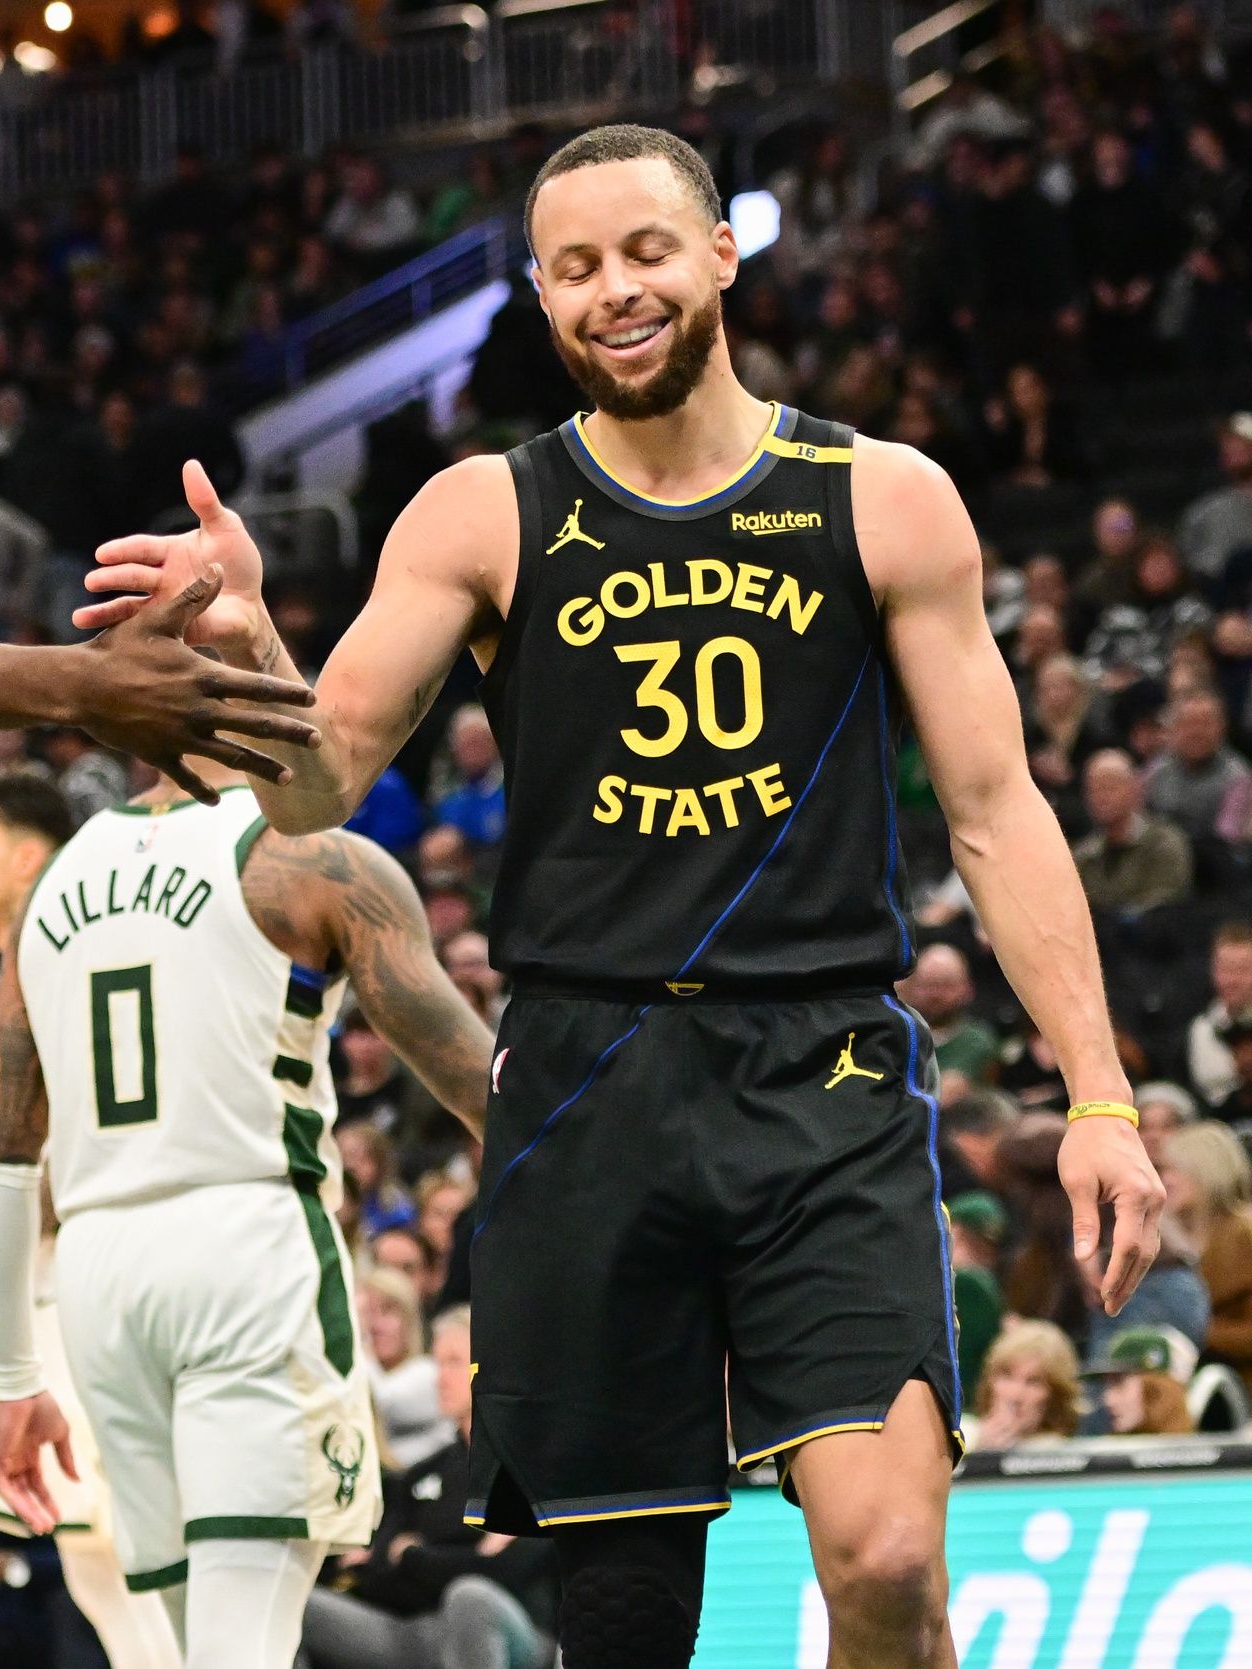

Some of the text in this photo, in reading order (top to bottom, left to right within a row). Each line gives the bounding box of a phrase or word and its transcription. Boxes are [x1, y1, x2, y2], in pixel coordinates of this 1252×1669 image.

[796, 445, 817, 459] 16
[731, 510, 822, 531] Rakuten
[557, 558, 824, 647] GOLDEN
[613, 635, 764, 758] 30
[592, 762, 793, 837] STATE
[37, 863, 212, 952] LILLARD
[91, 964, 158, 1128] 0
